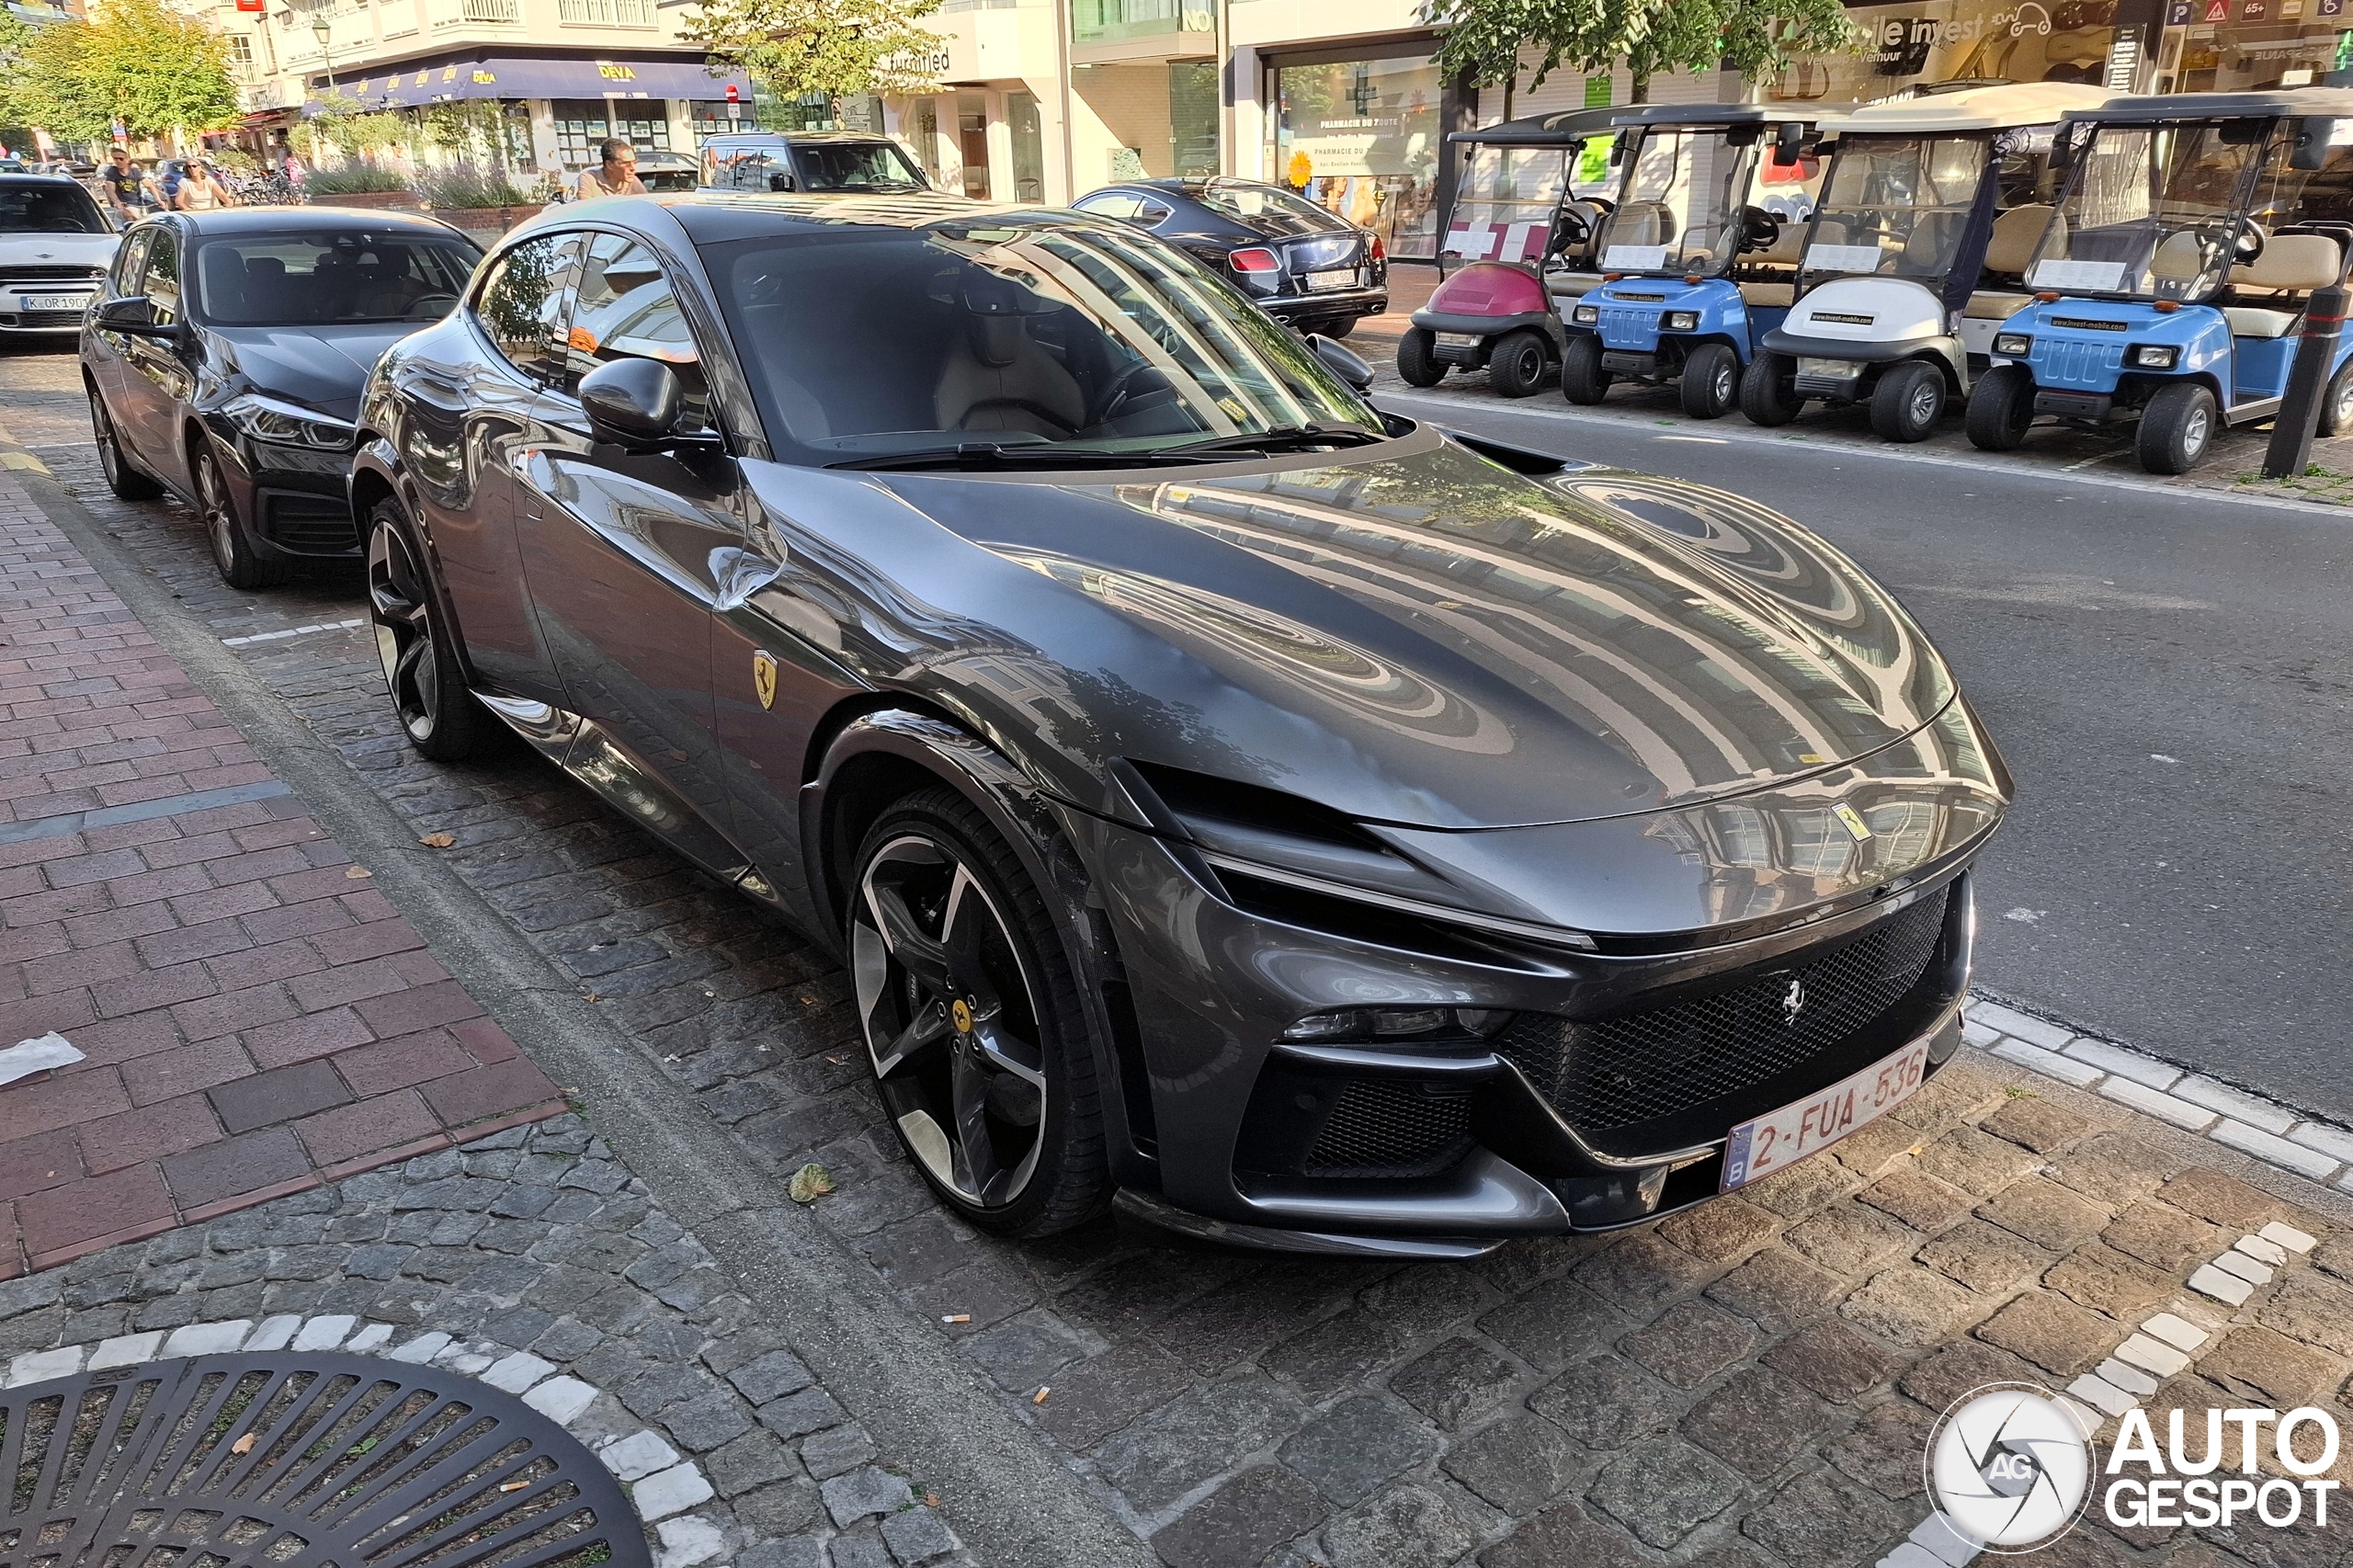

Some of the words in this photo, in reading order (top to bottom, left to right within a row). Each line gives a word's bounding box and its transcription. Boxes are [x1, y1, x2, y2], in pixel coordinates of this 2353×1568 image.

[2245, 3, 2265, 14] 65+
[1910, 13, 1984, 44] invest
[1859, 51, 1902, 63] Verhuur
[472, 73, 496, 83] DEVA
[597, 66, 636, 79] DEVA
[1320, 119, 1360, 129] PHARMACIE
[1361, 119, 1373, 128] DU
[1374, 118, 1398, 126] ZOUTE
[28, 298, 38, 308] K
[1812, 314, 1872, 324] www.invest-mobile.com
[2052, 320, 2126, 331] www.invest-mobile.com
[1752, 1048, 1924, 1171] 2-FUA-536
[1729, 1161, 1745, 1183] B
